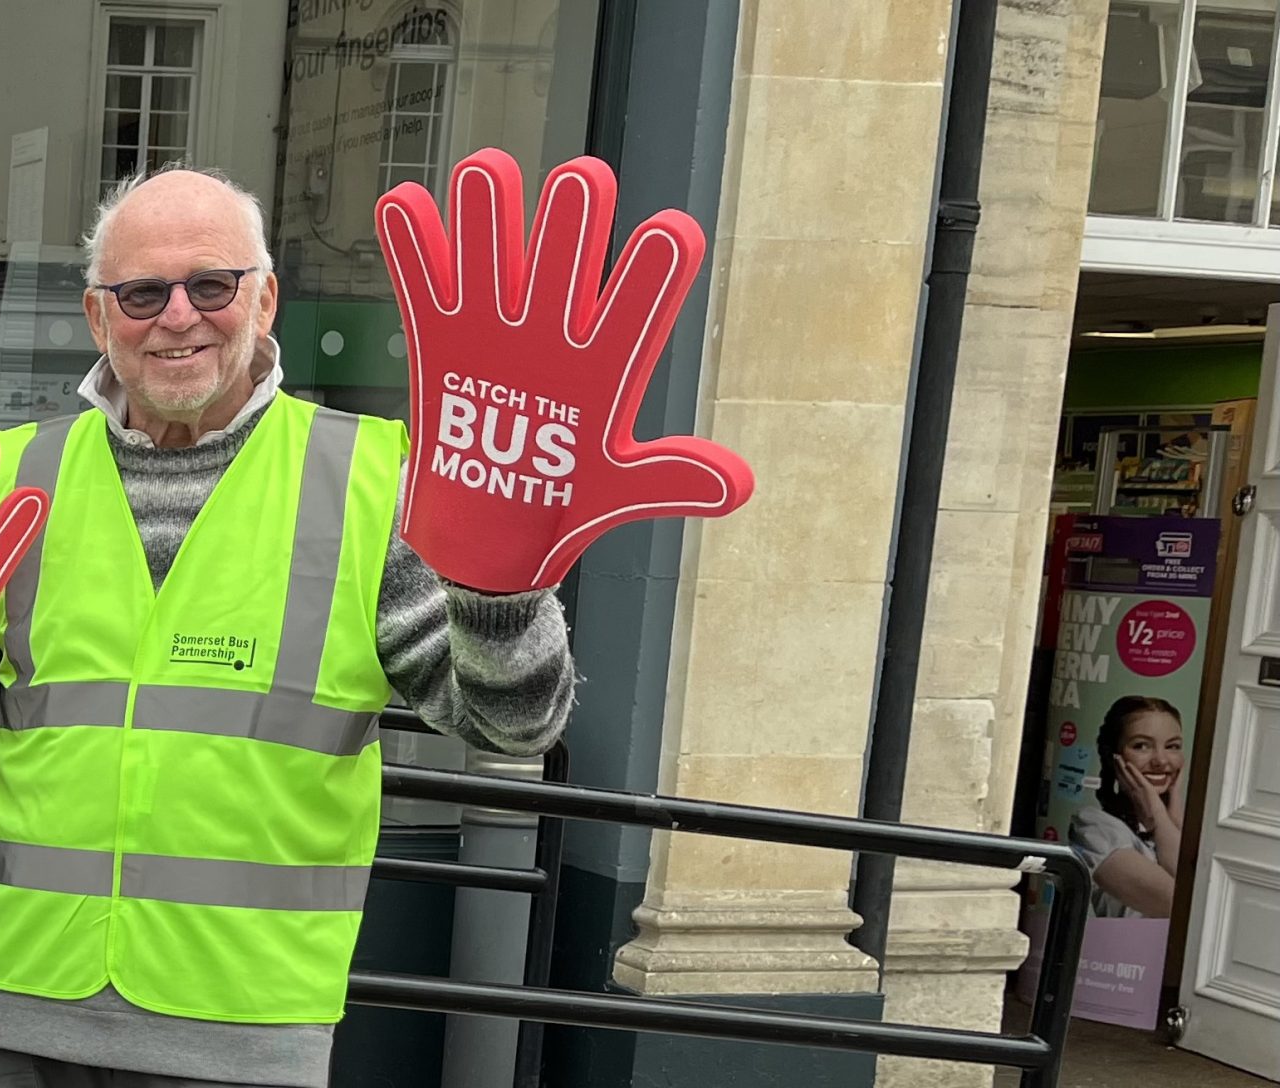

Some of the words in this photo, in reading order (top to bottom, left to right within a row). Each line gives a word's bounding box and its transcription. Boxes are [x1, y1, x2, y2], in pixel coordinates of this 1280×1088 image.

[283, 47, 330, 95] your
[334, 6, 448, 71] fingertips
[443, 371, 527, 411] CATCH
[534, 395, 581, 427] THE
[437, 391, 577, 478] BUS
[431, 444, 574, 507] MONTH
[171, 645, 235, 661] Partnership
[172, 633, 225, 647] Somerset
[228, 636, 249, 649] Bus
[1156, 629, 1186, 640] price
[1090, 961, 1115, 974] OUR
[1116, 962, 1146, 981] DUTY
